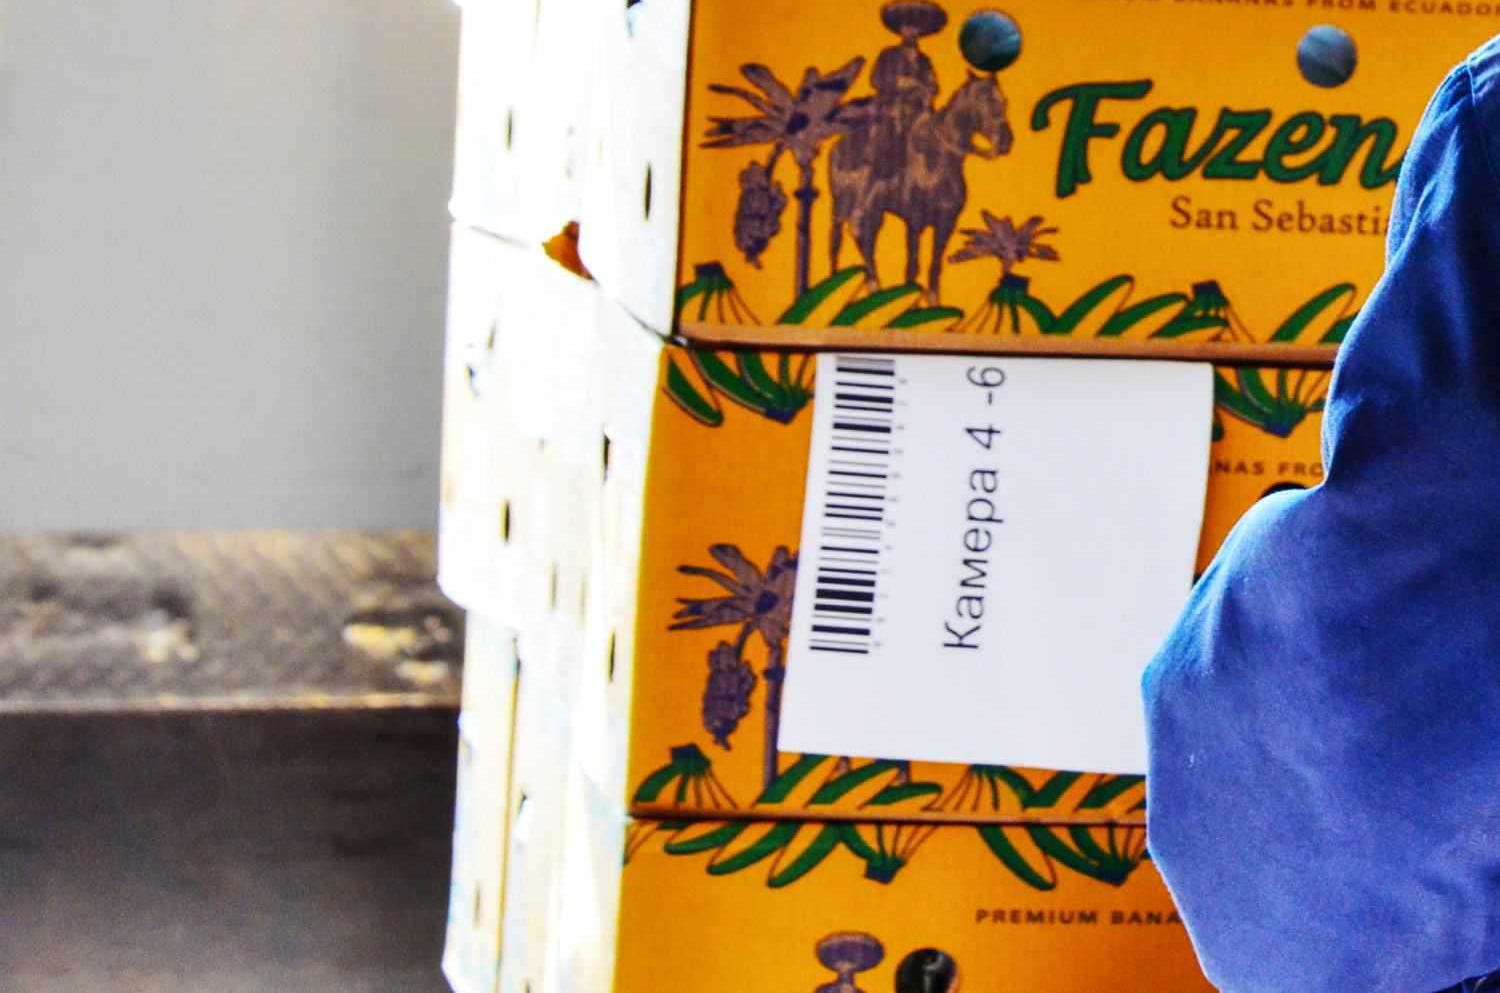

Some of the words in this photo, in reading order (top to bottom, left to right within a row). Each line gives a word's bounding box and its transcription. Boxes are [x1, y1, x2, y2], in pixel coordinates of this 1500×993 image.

[1169, 195, 1238, 231] San
[1252, 199, 1389, 236] Sebasti
[964, 423, 1003, 450] 4
[942, 468, 1004, 650] Камера
[975, 909, 1098, 925] PREMIUM
